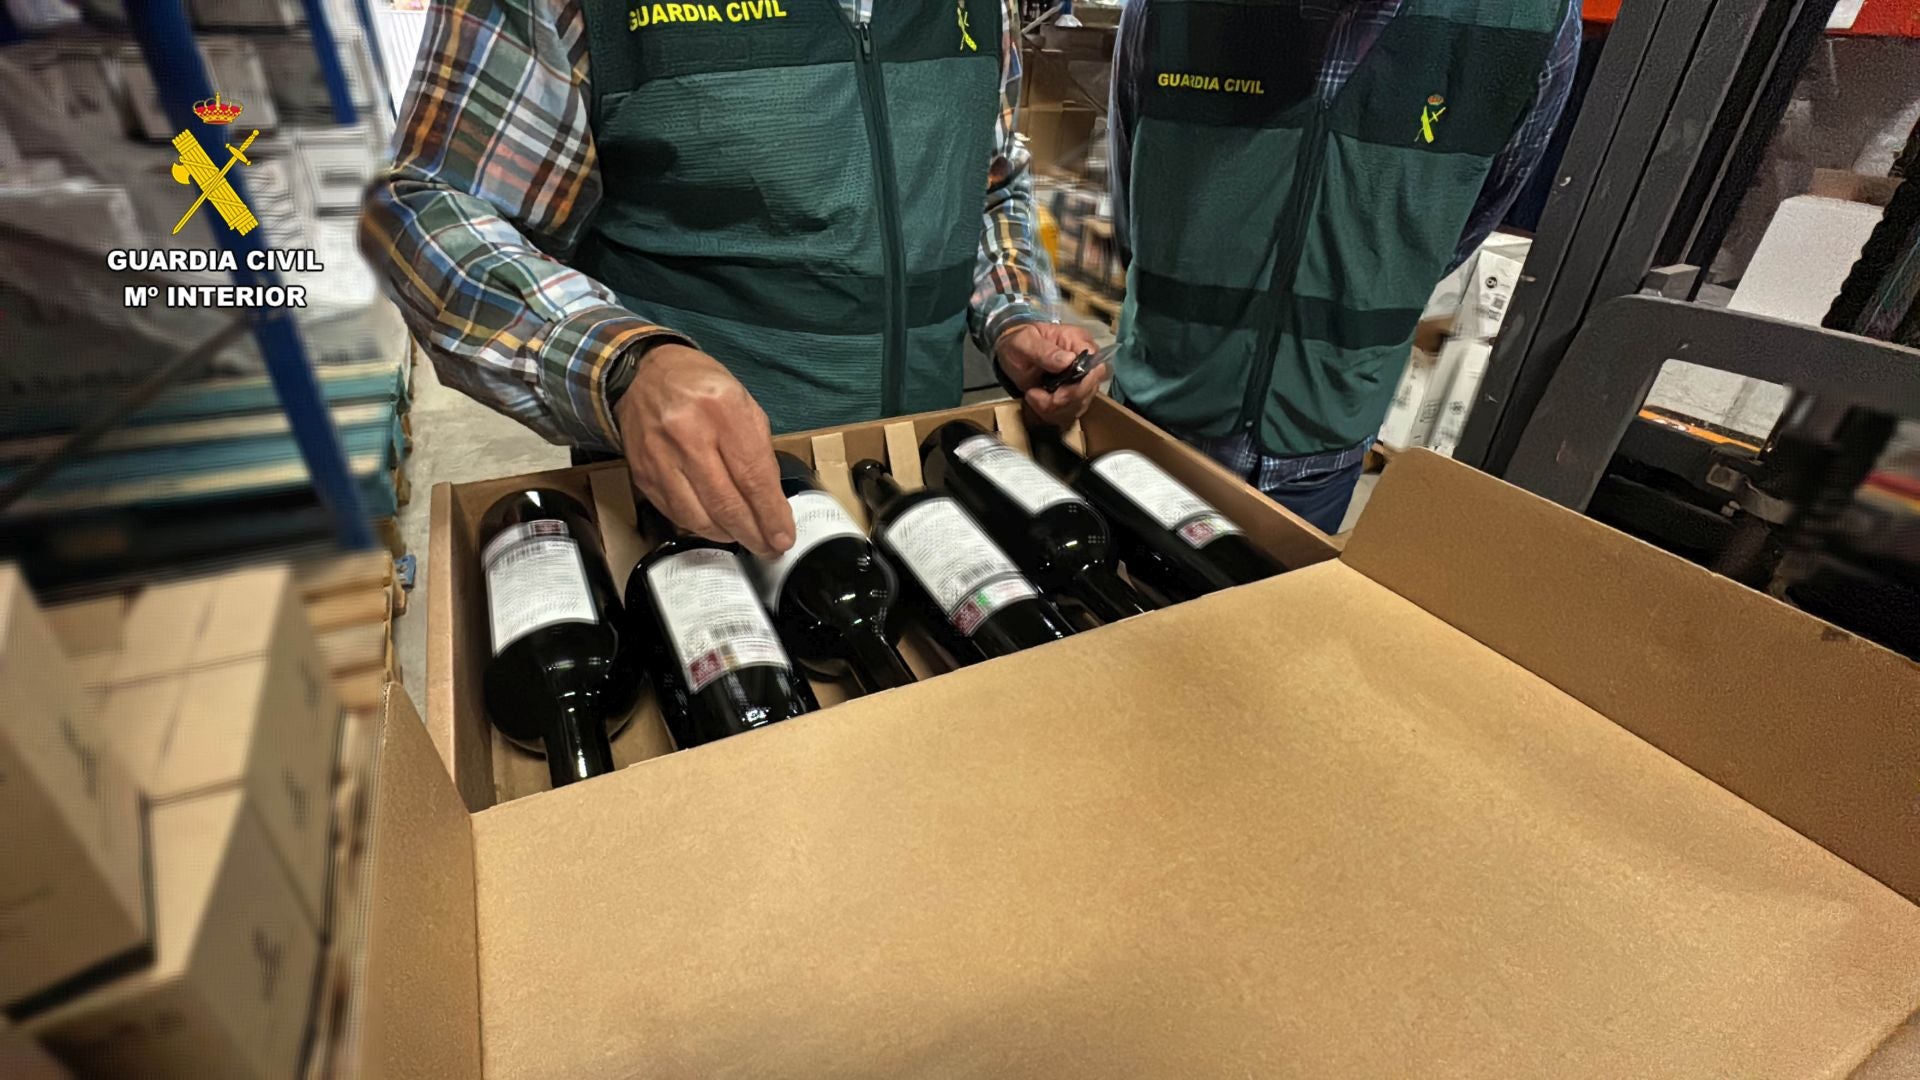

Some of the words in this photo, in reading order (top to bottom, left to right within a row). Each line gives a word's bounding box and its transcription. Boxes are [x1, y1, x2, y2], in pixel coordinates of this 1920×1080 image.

[628, 2, 721, 31] GUARDIA
[726, 0, 787, 22] CIVIL
[1157, 73, 1220, 91] GUARDIA
[1224, 78, 1265, 94] CIVIL
